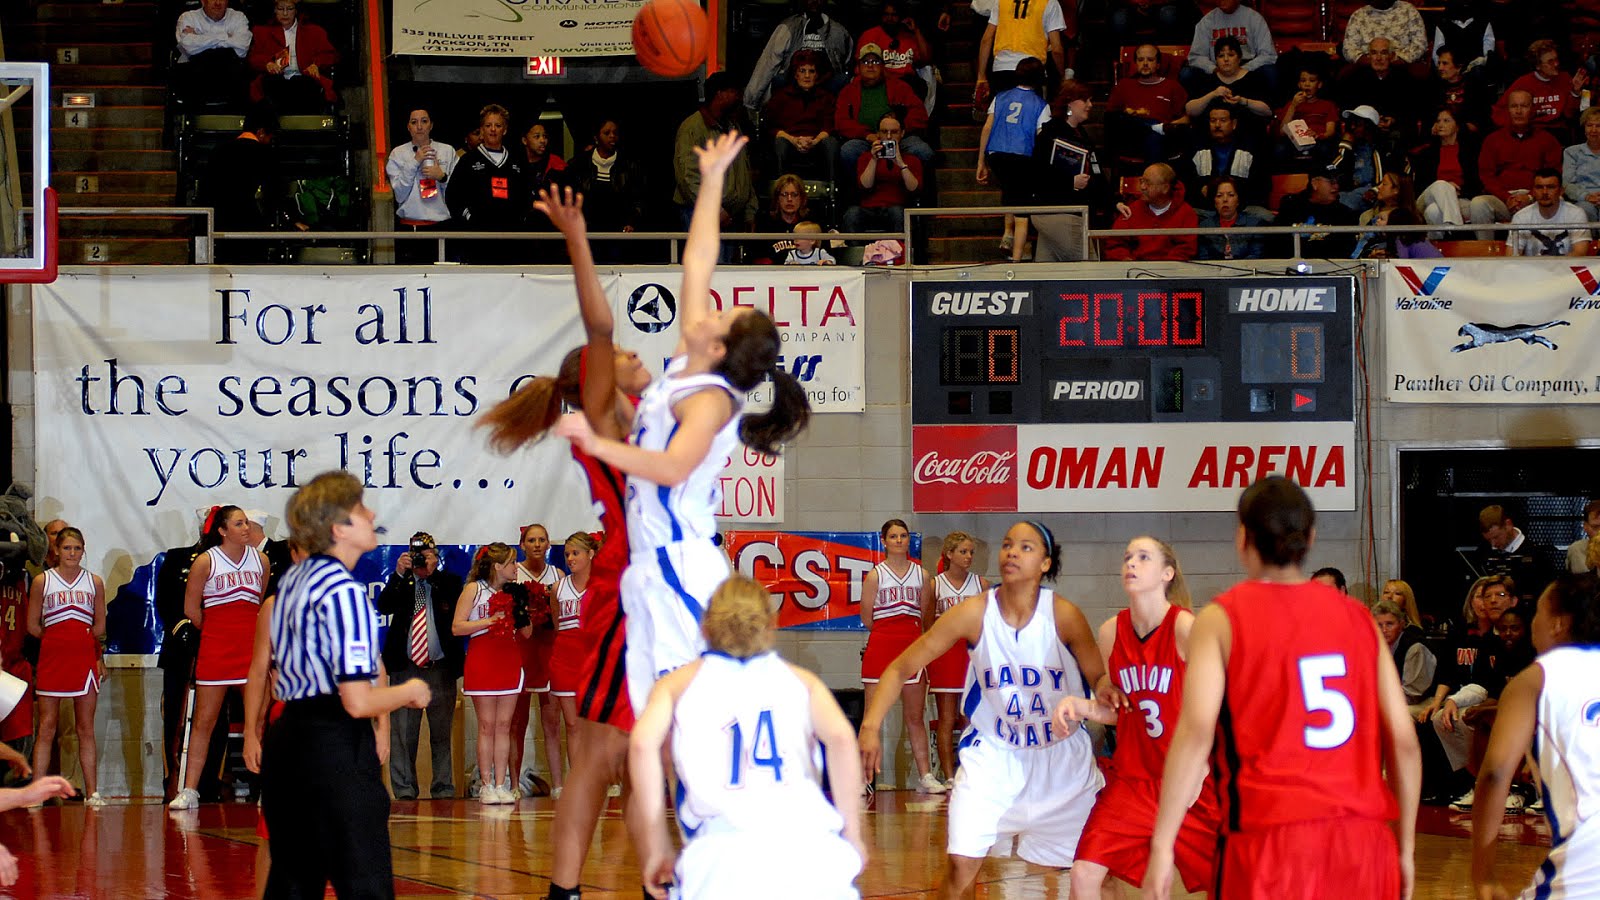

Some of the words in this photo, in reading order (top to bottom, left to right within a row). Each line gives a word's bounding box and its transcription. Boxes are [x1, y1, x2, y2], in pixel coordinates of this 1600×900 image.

[1014, 0, 1031, 19] 11
[401, 28, 424, 36] 335
[428, 31, 484, 40] BELLVUE
[425, 39, 490, 47] JACKSON,
[64, 51, 71, 63] 5
[527, 56, 561, 75] EXIT
[71, 113, 79, 126] 4
[1005, 101, 1023, 124] 2
[81, 179, 89, 191] 3
[92, 246, 101, 259] 2
[931, 291, 1029, 316] GUEST
[1238, 288, 1327, 312] HOME
[1395, 297, 1453, 310] Valvoline
[215, 289, 327, 345] For
[355, 286, 438, 345] all
[1060, 293, 1203, 346] 20:00
[780, 332, 857, 343] OMPANY
[1291, 326, 1320, 380] 0
[75, 358, 189, 417] the
[217, 375, 481, 417] seasons
[1053, 380, 1141, 400] PERIOD
[1394, 374, 1463, 392] Panther
[1468, 374, 1496, 392] Oil
[1501, 374, 1588, 396] Company,
[142, 447, 308, 507] your
[913, 450, 1016, 485] Coca-Cola
[1026, 446, 1166, 490] OMAN
[1187, 445, 1346, 488] ARENA
[714, 476, 776, 517] ION
[215, 571, 262, 592] UNION
[47, 590, 95, 609] UNION
[983, 664, 1064, 691] LADY
[1119, 664, 1173, 694] UNION
[1006, 691, 1048, 722] 44
[1298, 653, 1356, 751] 5
[1138, 699, 1165, 739] 3
[722, 709, 784, 788] 14
